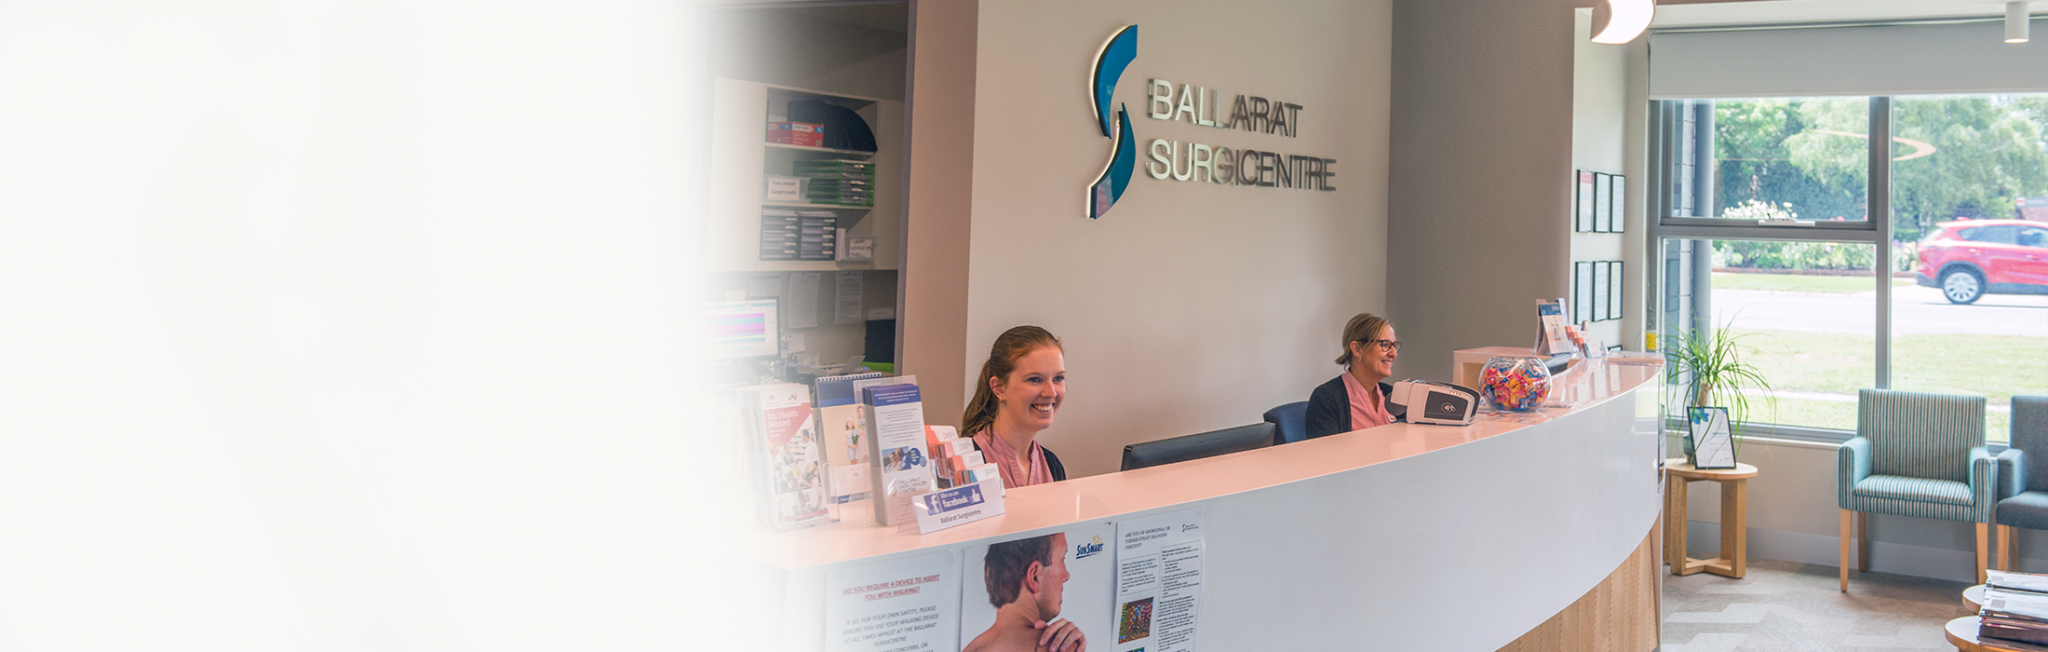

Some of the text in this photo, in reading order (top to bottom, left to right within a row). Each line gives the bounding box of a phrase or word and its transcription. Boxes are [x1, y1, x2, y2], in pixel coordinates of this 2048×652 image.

[1148, 78, 1303, 138] BALLARAT
[1146, 139, 1337, 191] SURGICENTRE
[942, 495, 970, 508] facebook
[940, 510, 982, 524] Ballarat Surgicentre
[866, 582, 890, 590] REQUIRE
[896, 578, 914, 586] DEVICE
[893, 586, 920, 596] WALKING?
[914, 622, 937, 631] BALLARAT
